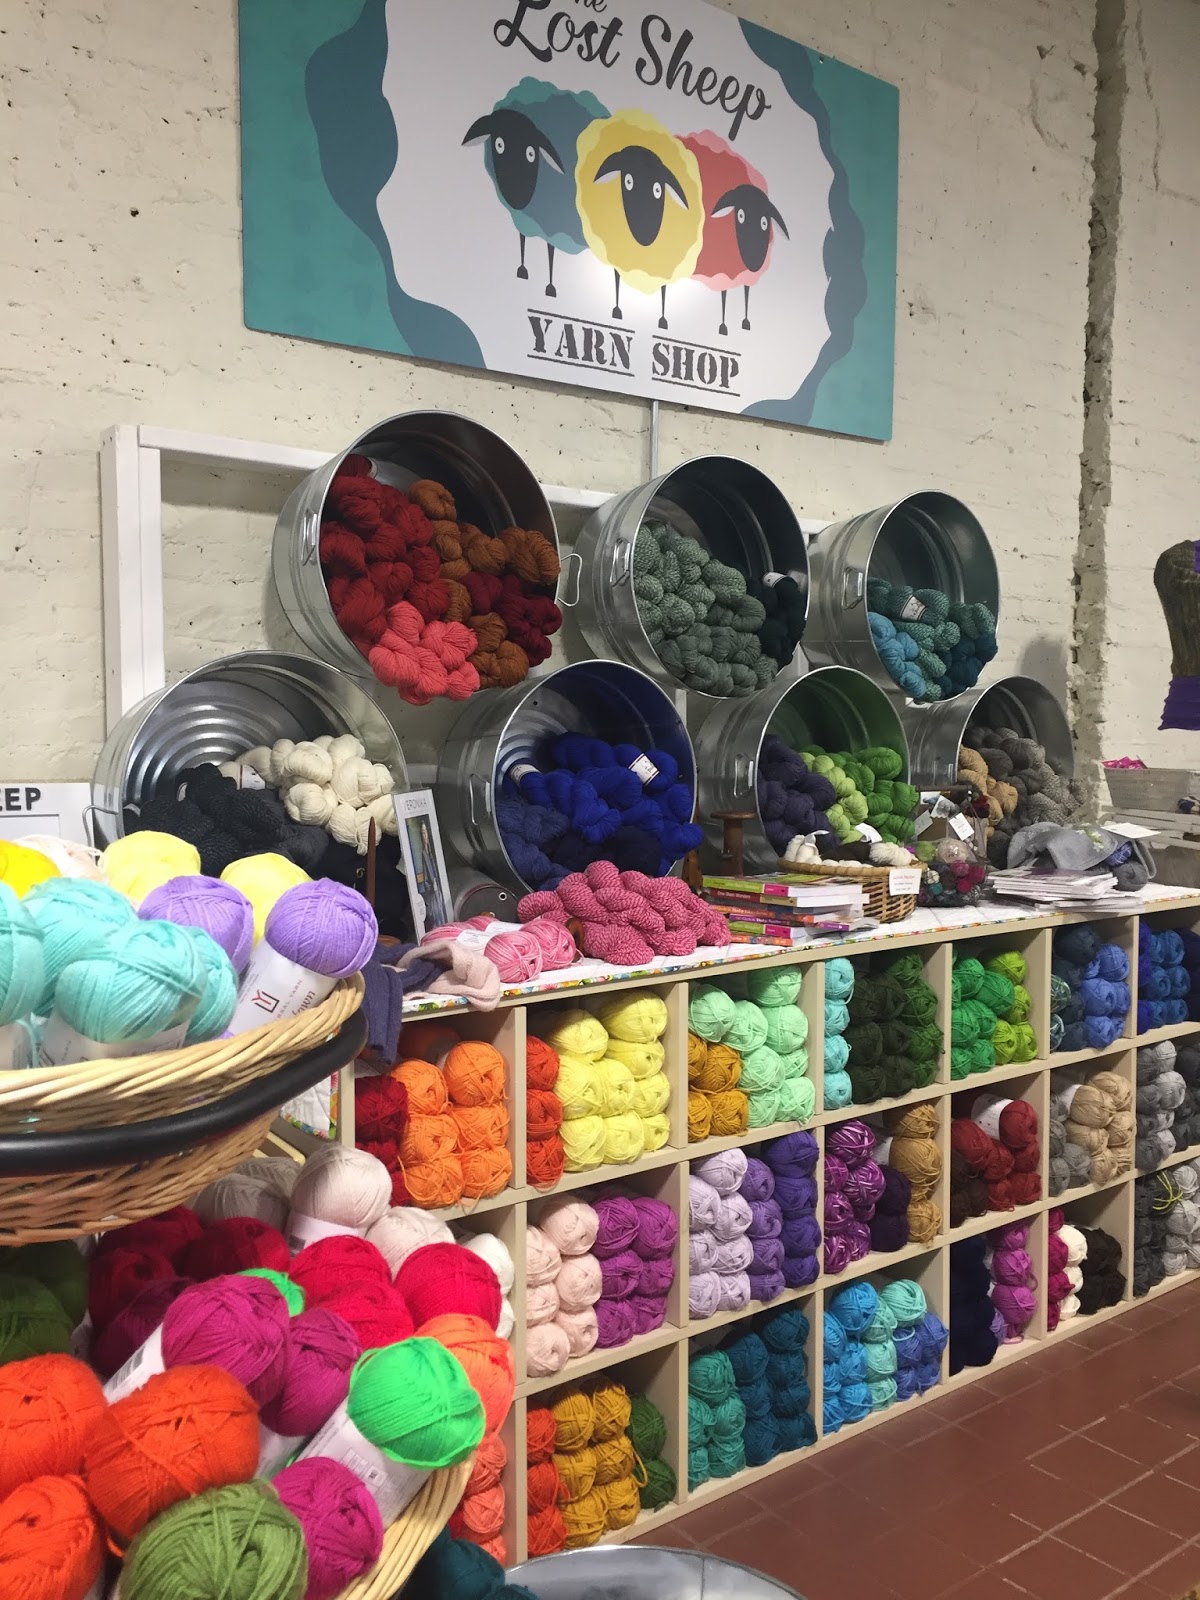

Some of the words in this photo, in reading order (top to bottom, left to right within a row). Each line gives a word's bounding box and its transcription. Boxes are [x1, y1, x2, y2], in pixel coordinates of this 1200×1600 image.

[493, 0, 624, 69] Lost
[635, 14, 772, 142] Sheep
[527, 315, 633, 371] YARN
[651, 341, 741, 389] SHOP
[0, 787, 42, 811] EP
